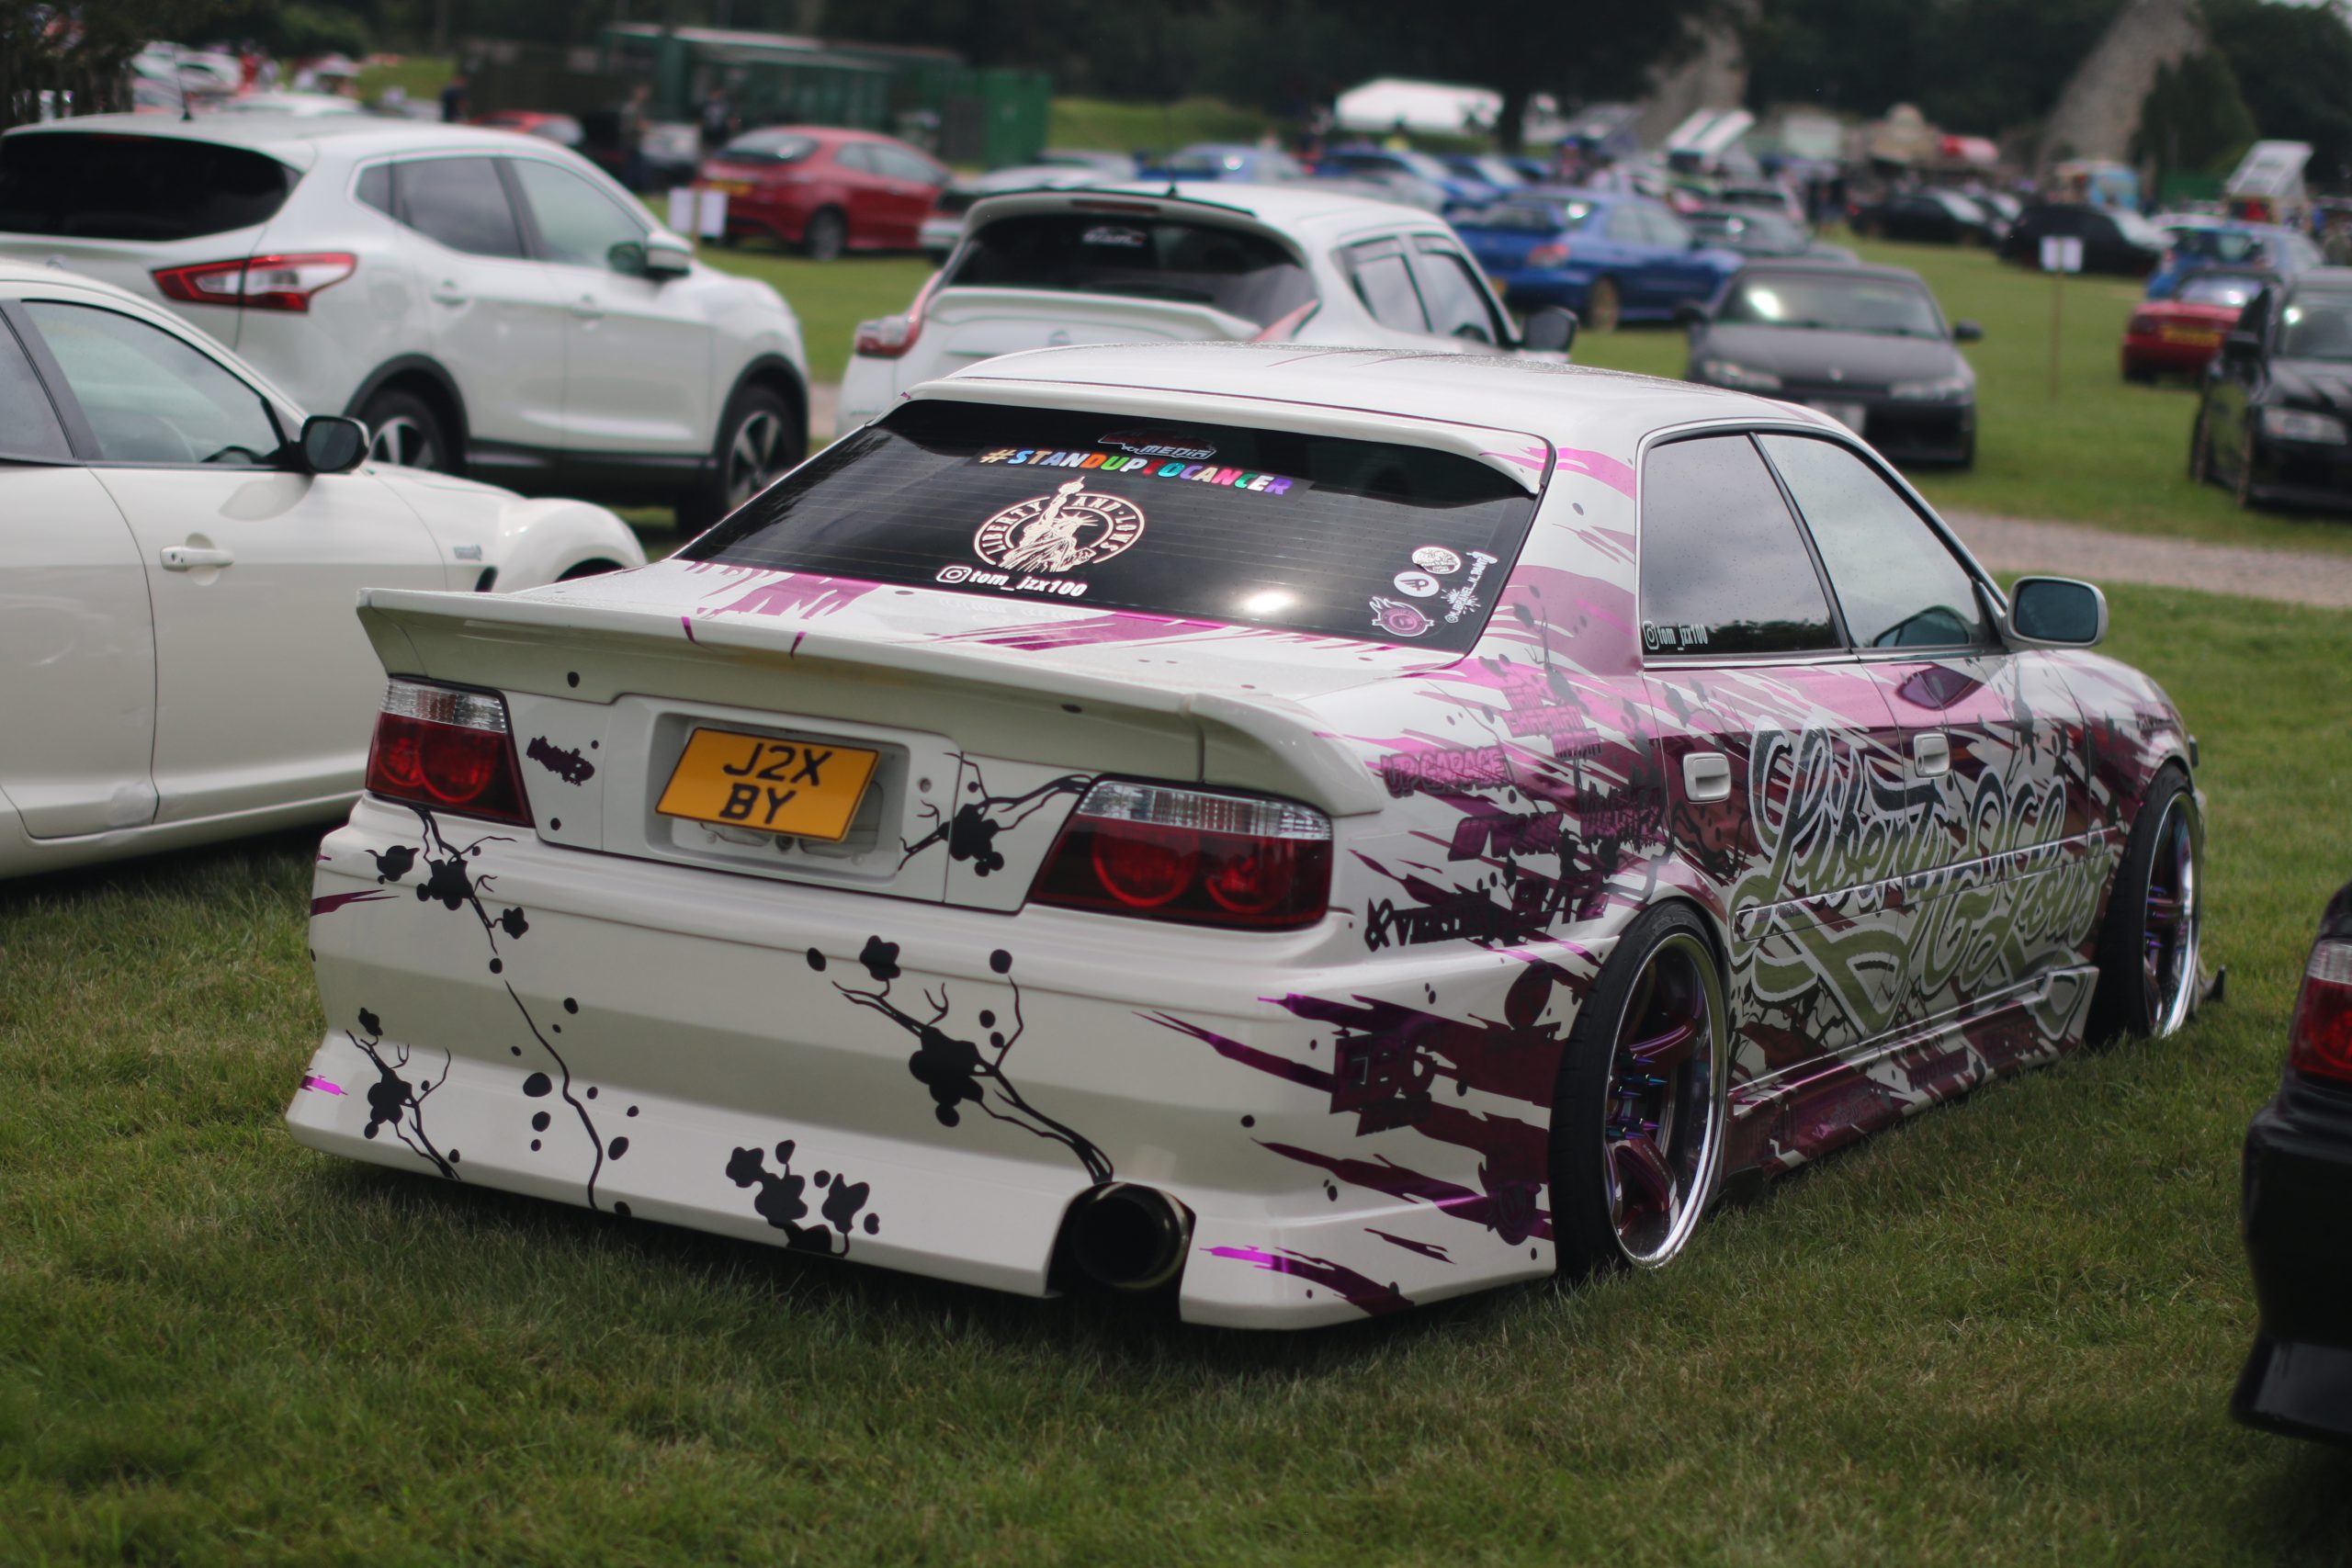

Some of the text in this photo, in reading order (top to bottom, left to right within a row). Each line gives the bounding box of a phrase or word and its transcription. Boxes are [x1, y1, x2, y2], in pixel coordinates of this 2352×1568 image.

[978, 446, 1295, 497] #STANDUPTOCANCER
[981, 501, 1044, 556] LIBERTY
[1072, 496, 1122, 513] AND
[969, 570, 1089, 598] tom_jzx100
[723, 742, 833, 787] J2X
[718, 782, 797, 825] BY
